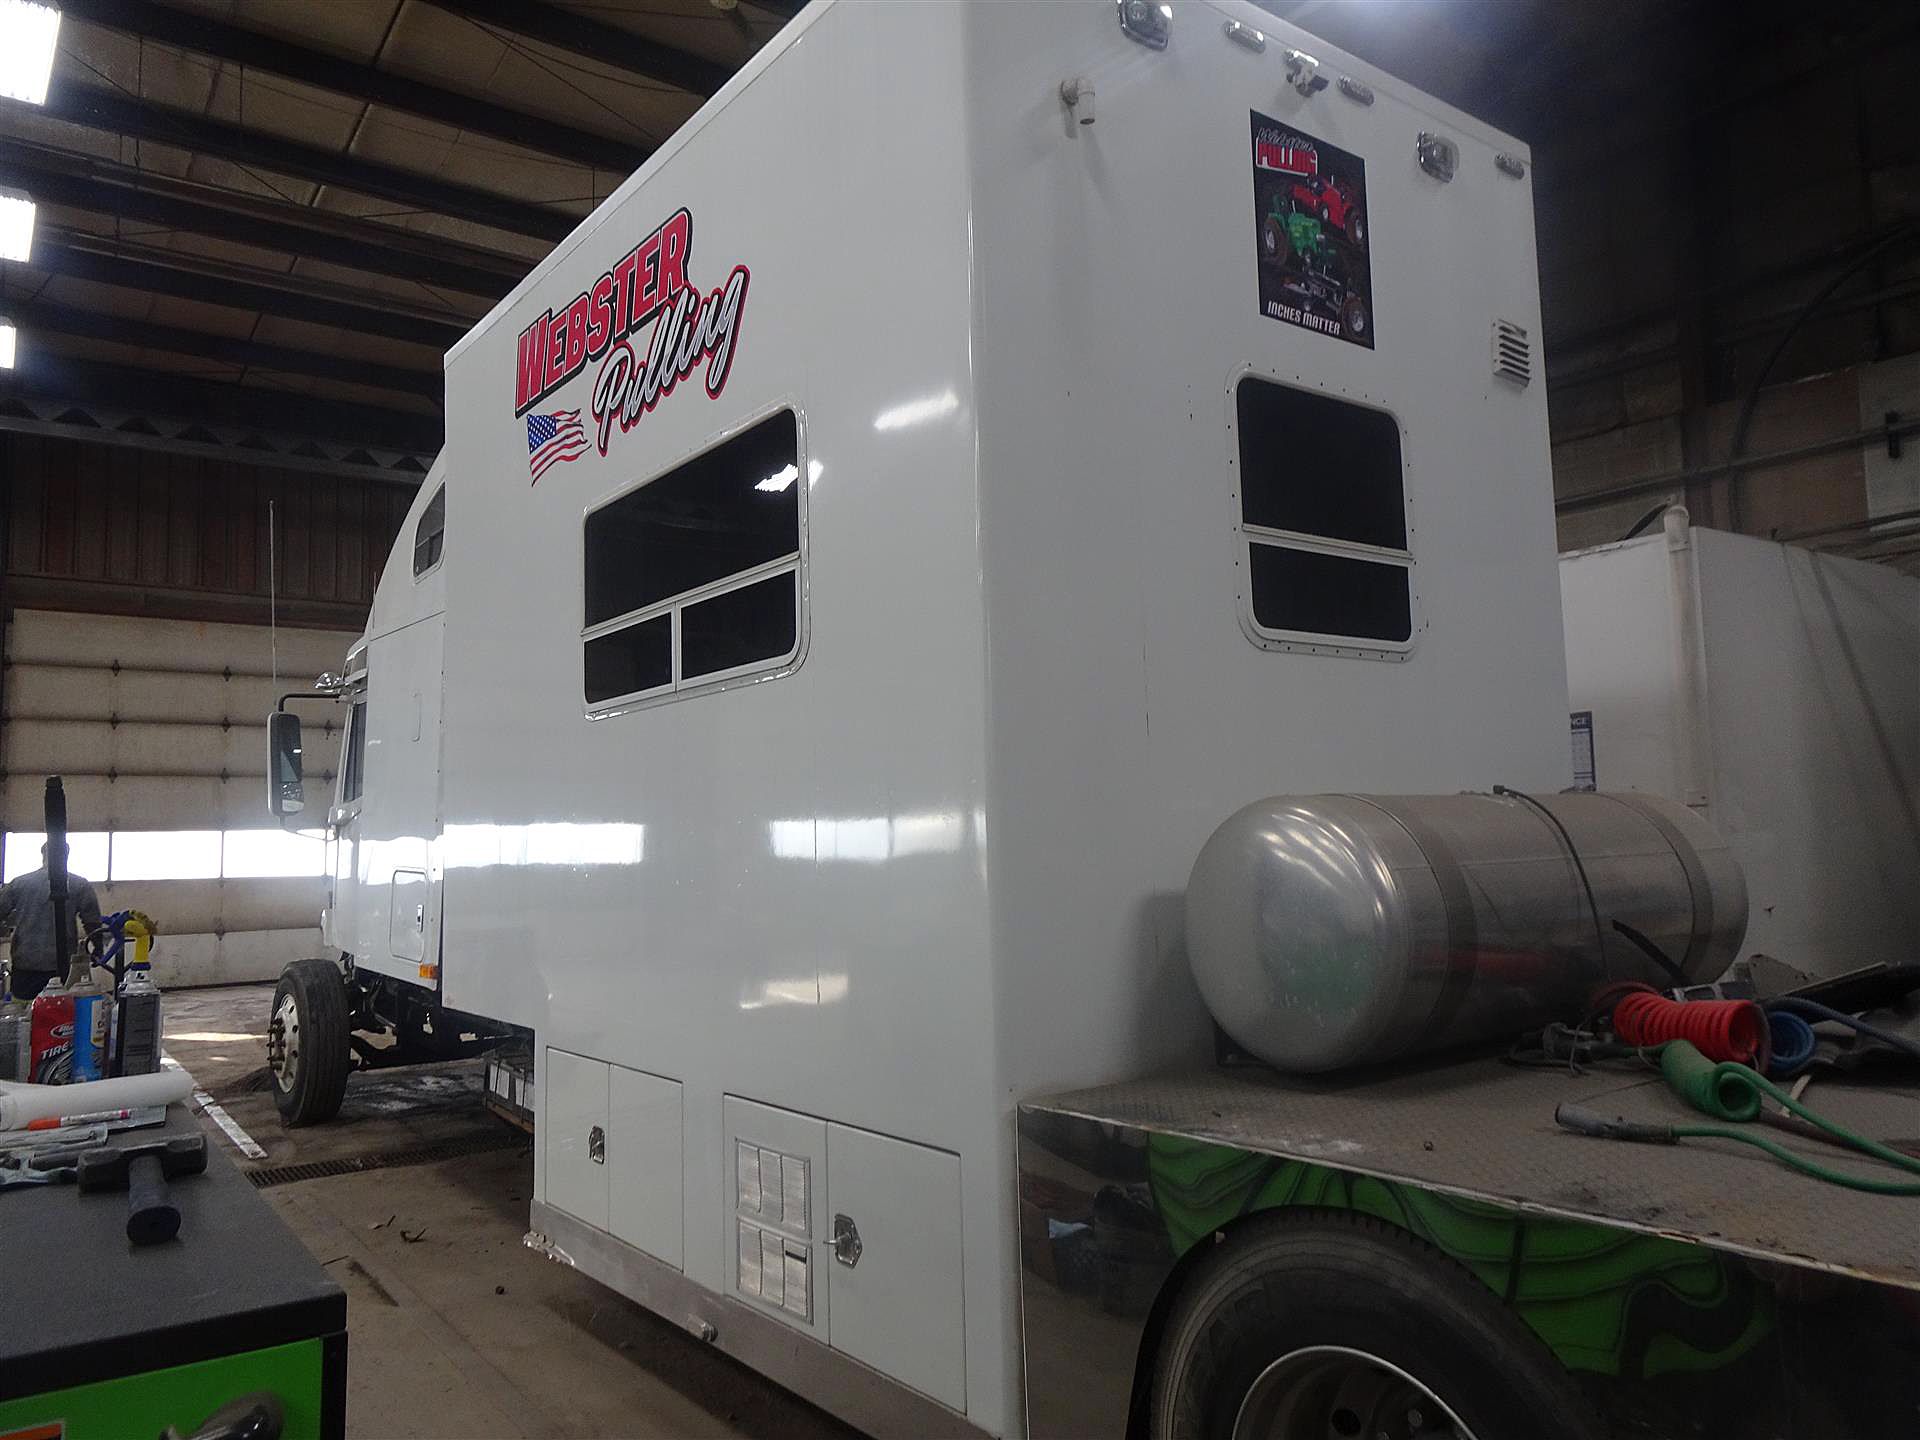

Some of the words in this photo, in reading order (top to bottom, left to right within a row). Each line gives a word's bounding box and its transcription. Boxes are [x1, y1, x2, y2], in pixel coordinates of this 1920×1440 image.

[515, 207, 693, 418] WEBSTER
[593, 266, 750, 456] Pulling
[1267, 299, 1302, 323] INCHES
[1302, 311, 1341, 336] MATTER
[40, 1040, 69, 1061] TIRE
